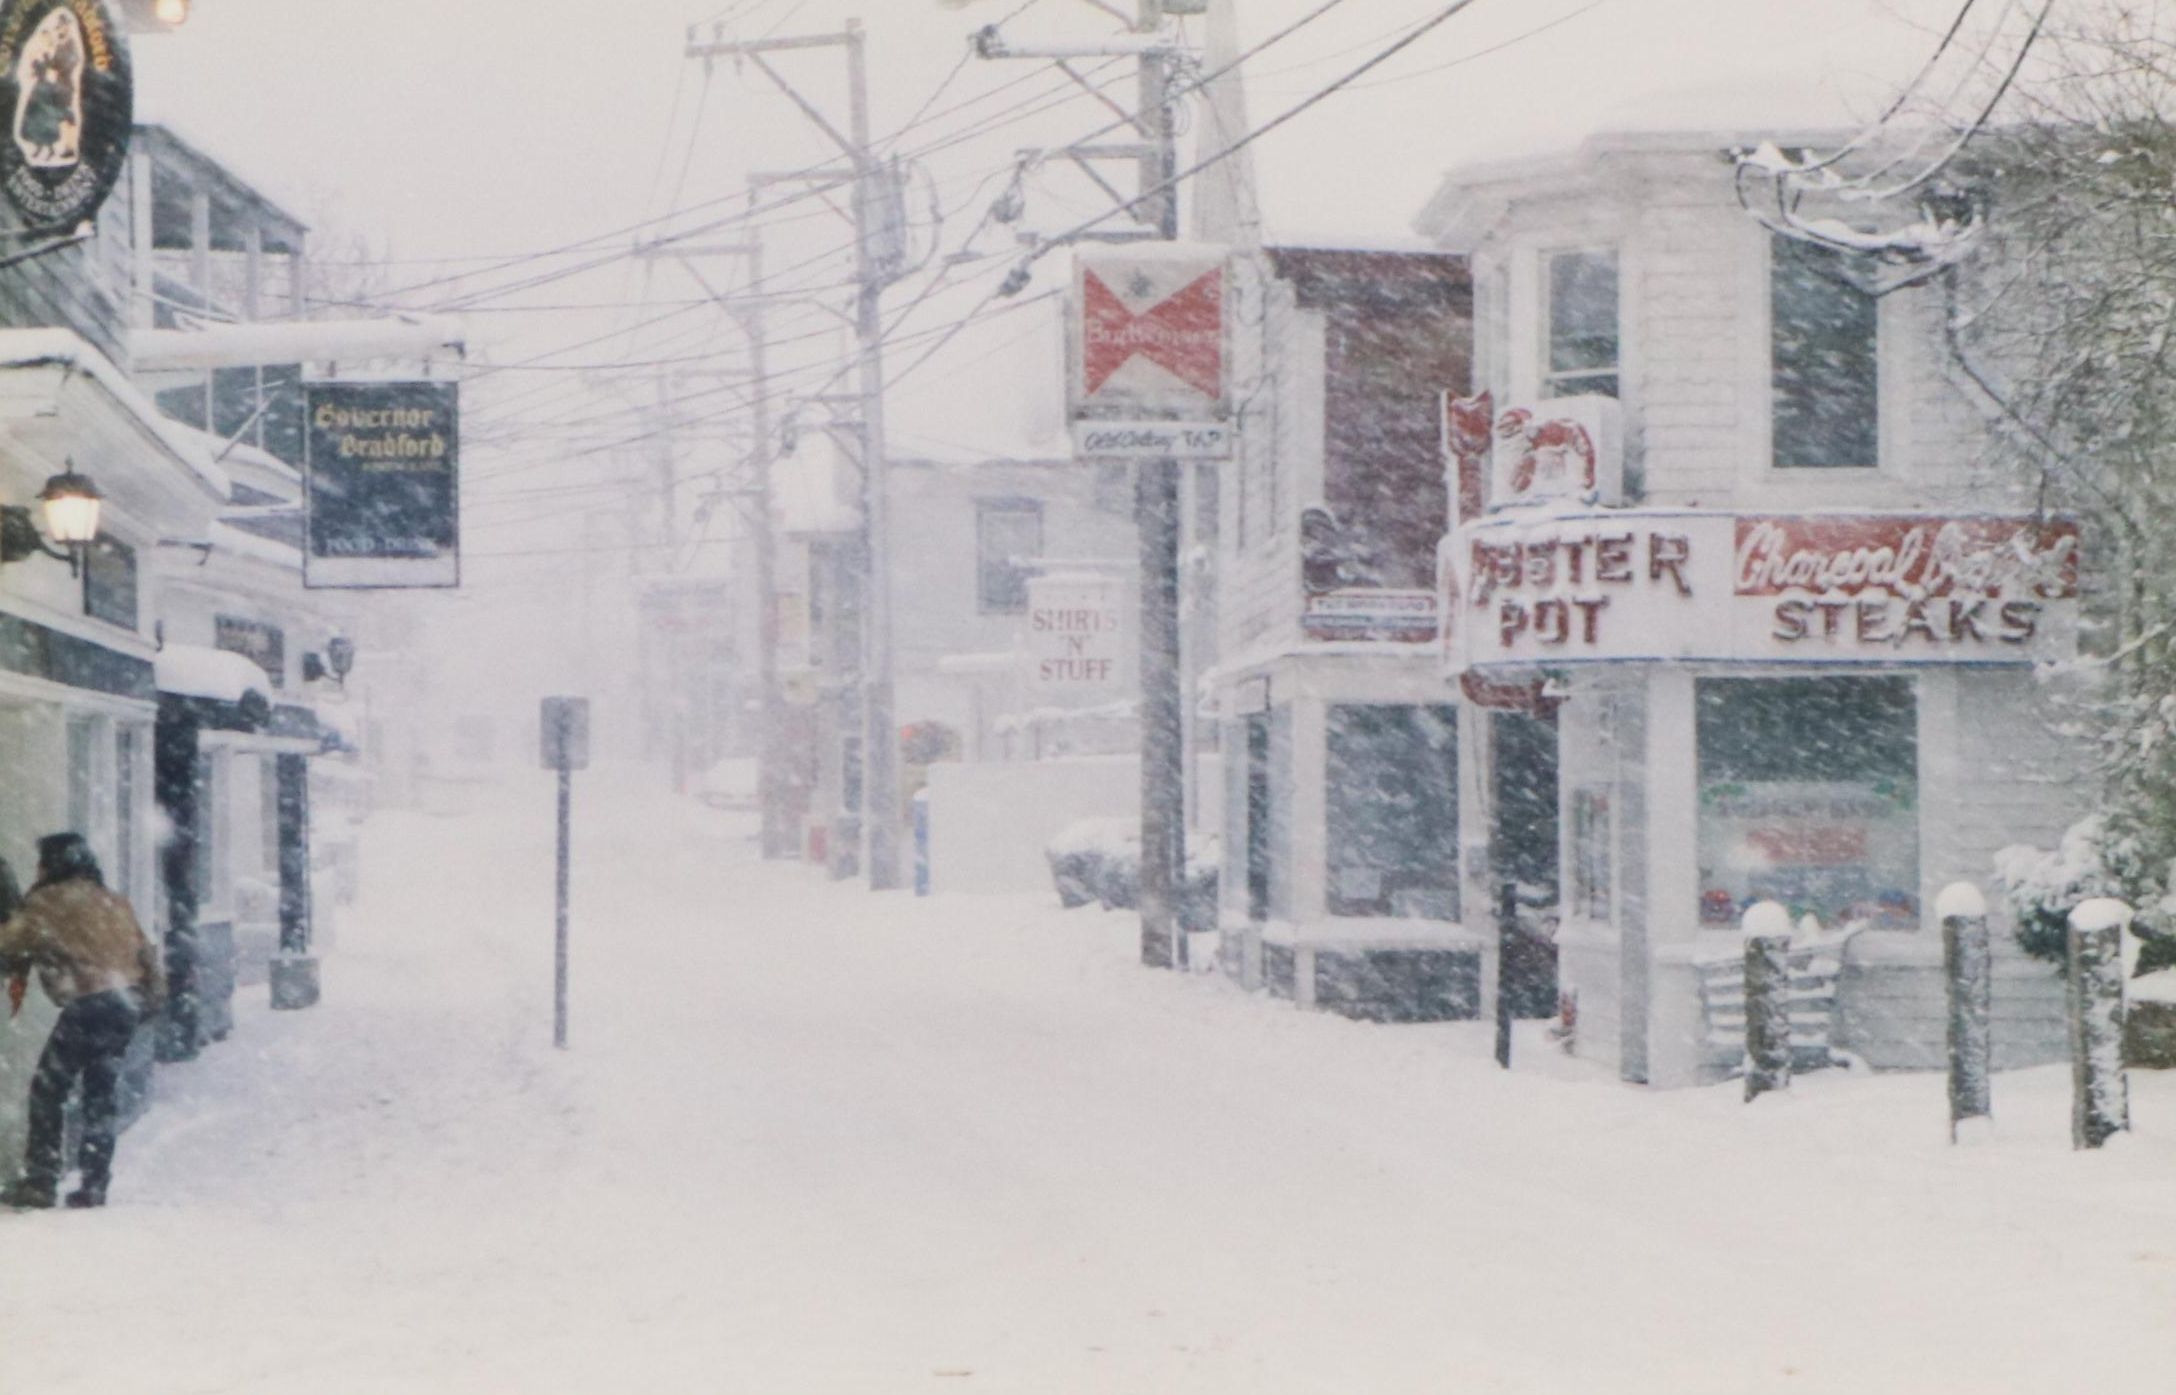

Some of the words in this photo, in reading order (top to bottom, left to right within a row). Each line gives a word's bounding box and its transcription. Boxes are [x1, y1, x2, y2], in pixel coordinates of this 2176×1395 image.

[314, 402, 434, 428] Governor
[339, 431, 446, 458] Bradford
[1735, 520, 1927, 601] Charcoal
[1031, 607, 1119, 632] SHIRTS
[1500, 595, 1611, 648] POT
[1772, 599, 2042, 645] STEAKS
[1039, 657, 1114, 682] STUFF
